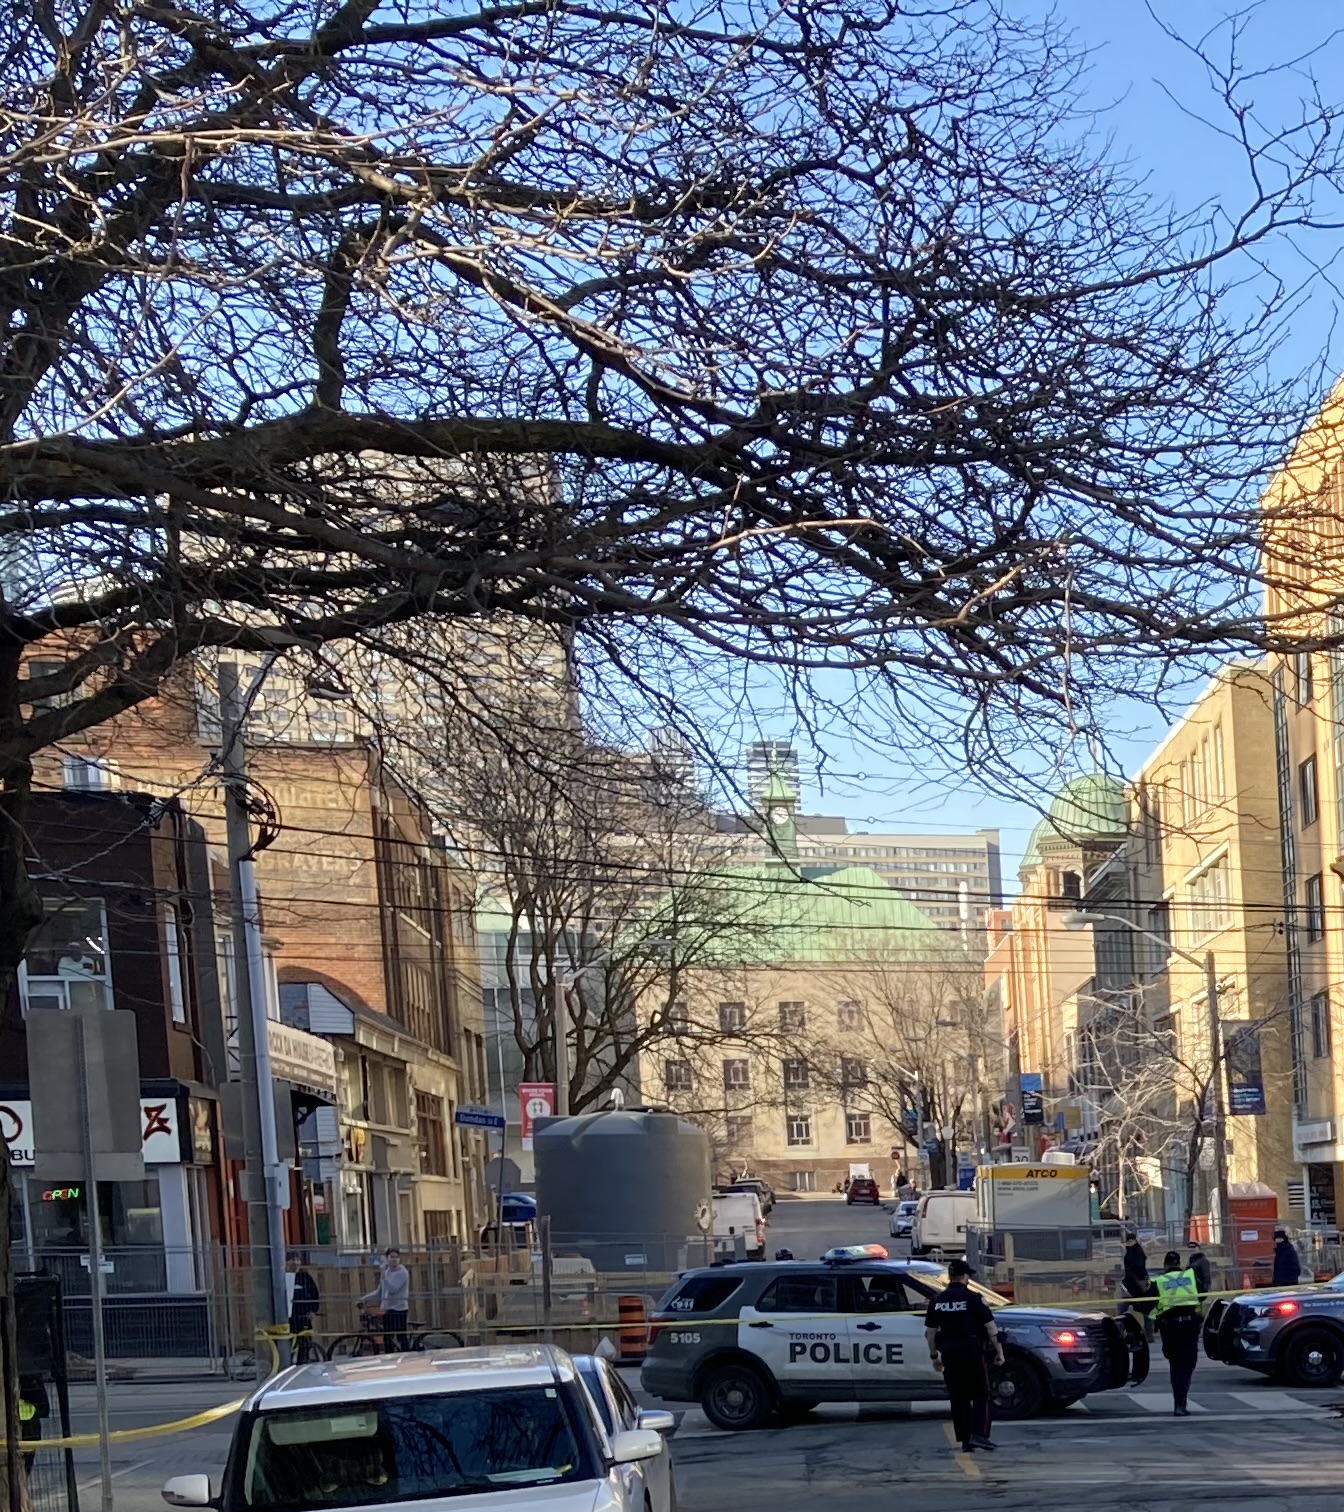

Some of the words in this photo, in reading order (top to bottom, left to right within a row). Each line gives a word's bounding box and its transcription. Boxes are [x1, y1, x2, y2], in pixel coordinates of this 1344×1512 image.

[460, 1114, 486, 1124] Dundas
[1025, 1169, 1058, 1178] ATCO
[42, 1188, 79, 1201] OPEN
[935, 1301, 967, 1311] POLICE
[670, 1332, 701, 1344] 5105
[789, 1333, 836, 1341] TORONTO
[789, 1343, 904, 1365] POLICE
